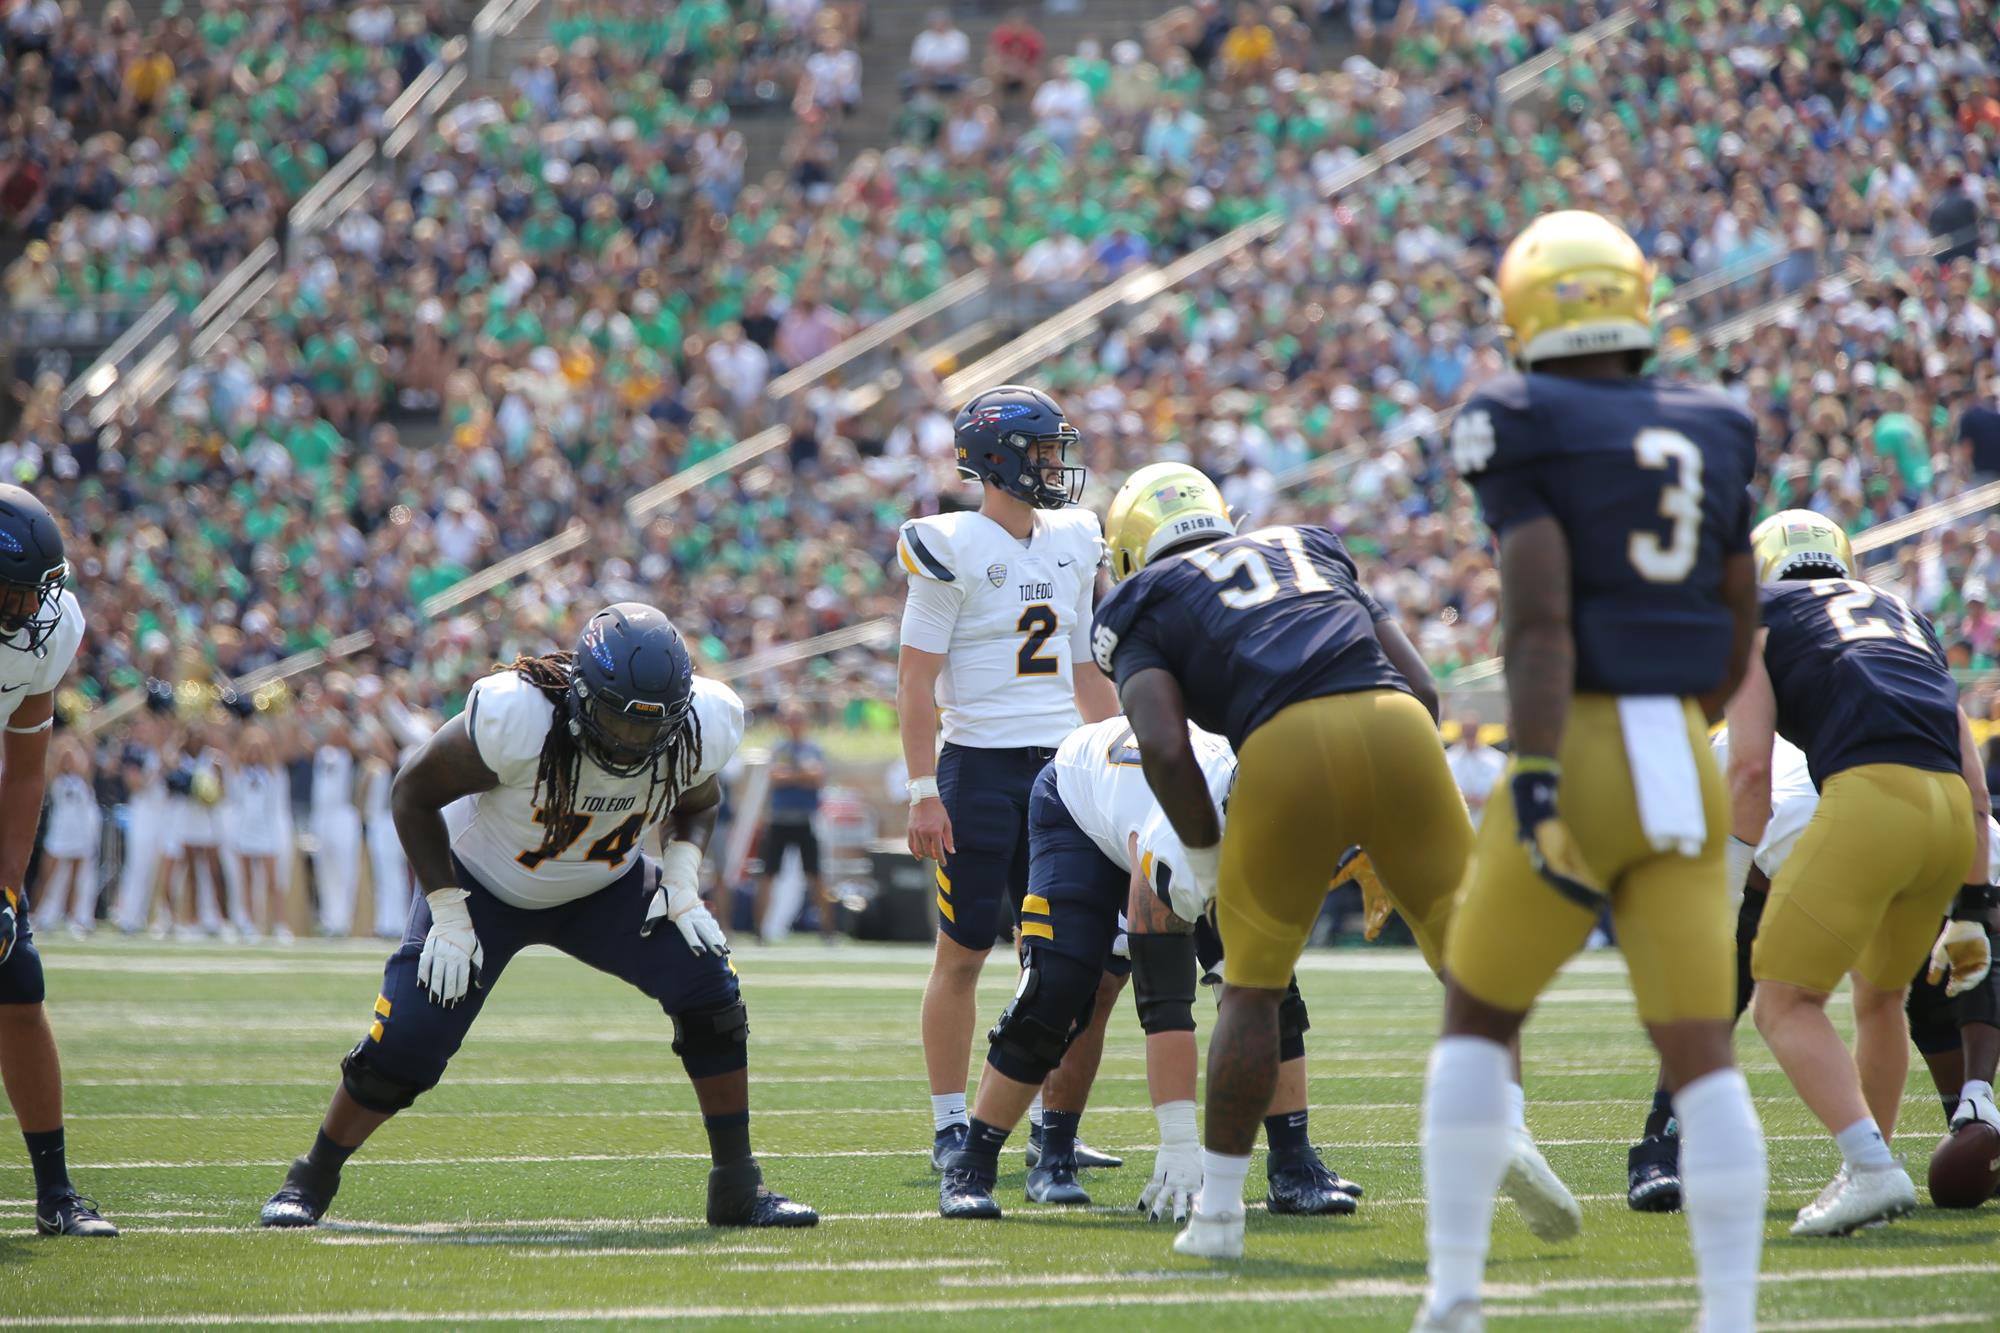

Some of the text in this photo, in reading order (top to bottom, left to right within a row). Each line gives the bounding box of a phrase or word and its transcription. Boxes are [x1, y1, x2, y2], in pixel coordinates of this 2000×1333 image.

[1174, 517, 1215, 534] IRISH
[1628, 426, 1704, 584] 3
[1019, 582, 1053, 601] TOLEDO
[1182, 525, 1335, 610] 57
[1016, 603, 1058, 677] 2
[581, 796, 636, 812] TOLEDO
[515, 806, 649, 872] 74
